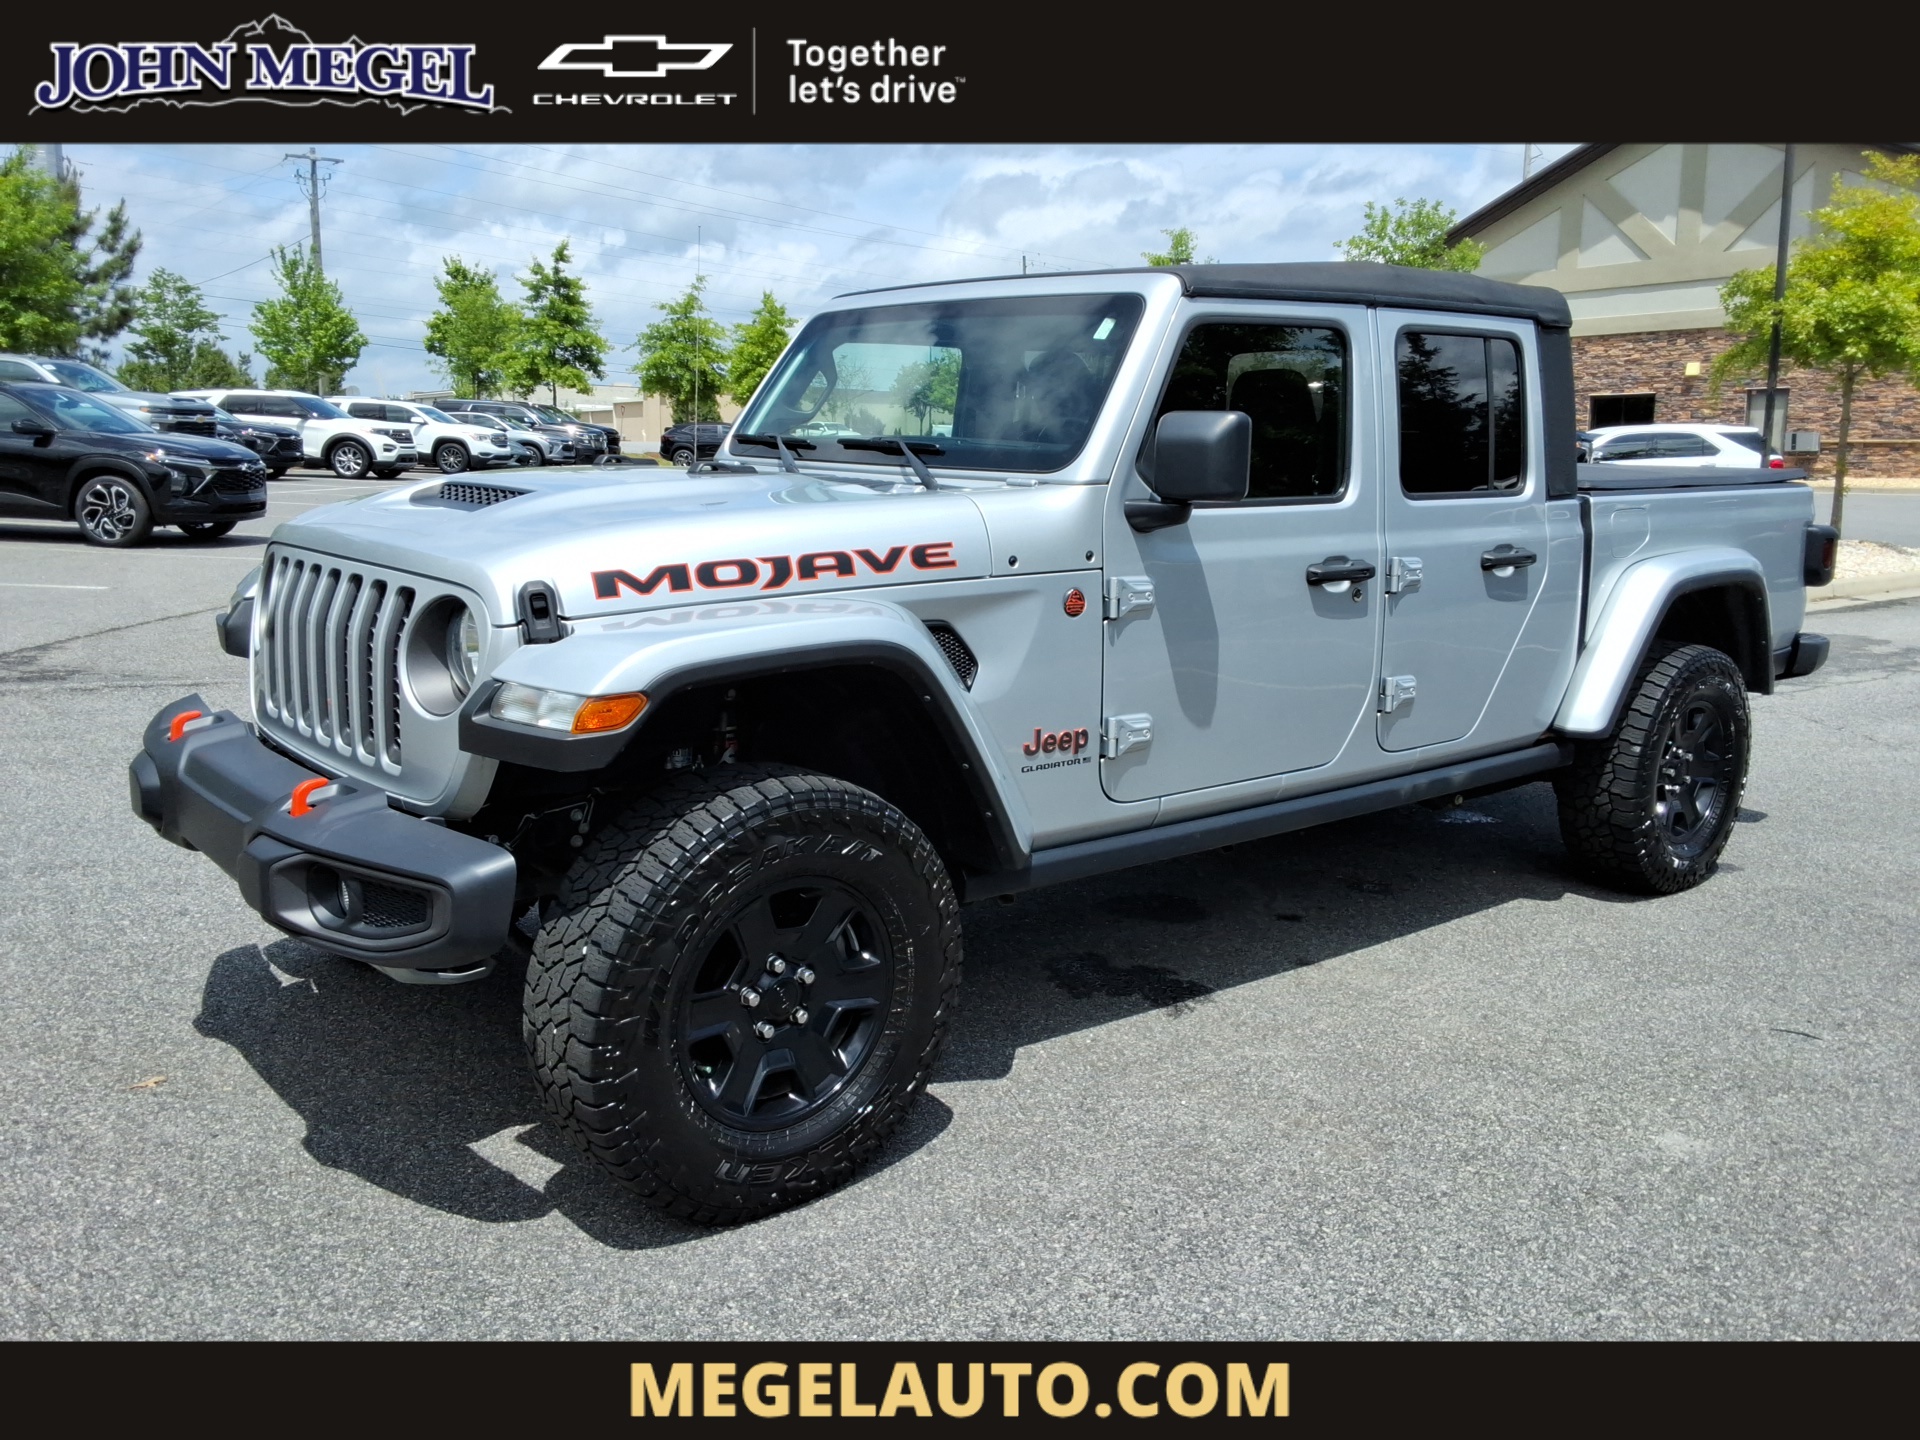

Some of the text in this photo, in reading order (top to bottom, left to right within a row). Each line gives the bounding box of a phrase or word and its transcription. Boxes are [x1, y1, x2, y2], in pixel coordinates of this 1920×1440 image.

[591, 541, 957, 600] MOJAVE
[1022, 726, 1089, 757] Jeep
[1021, 757, 1082, 774] GLADIATOR
